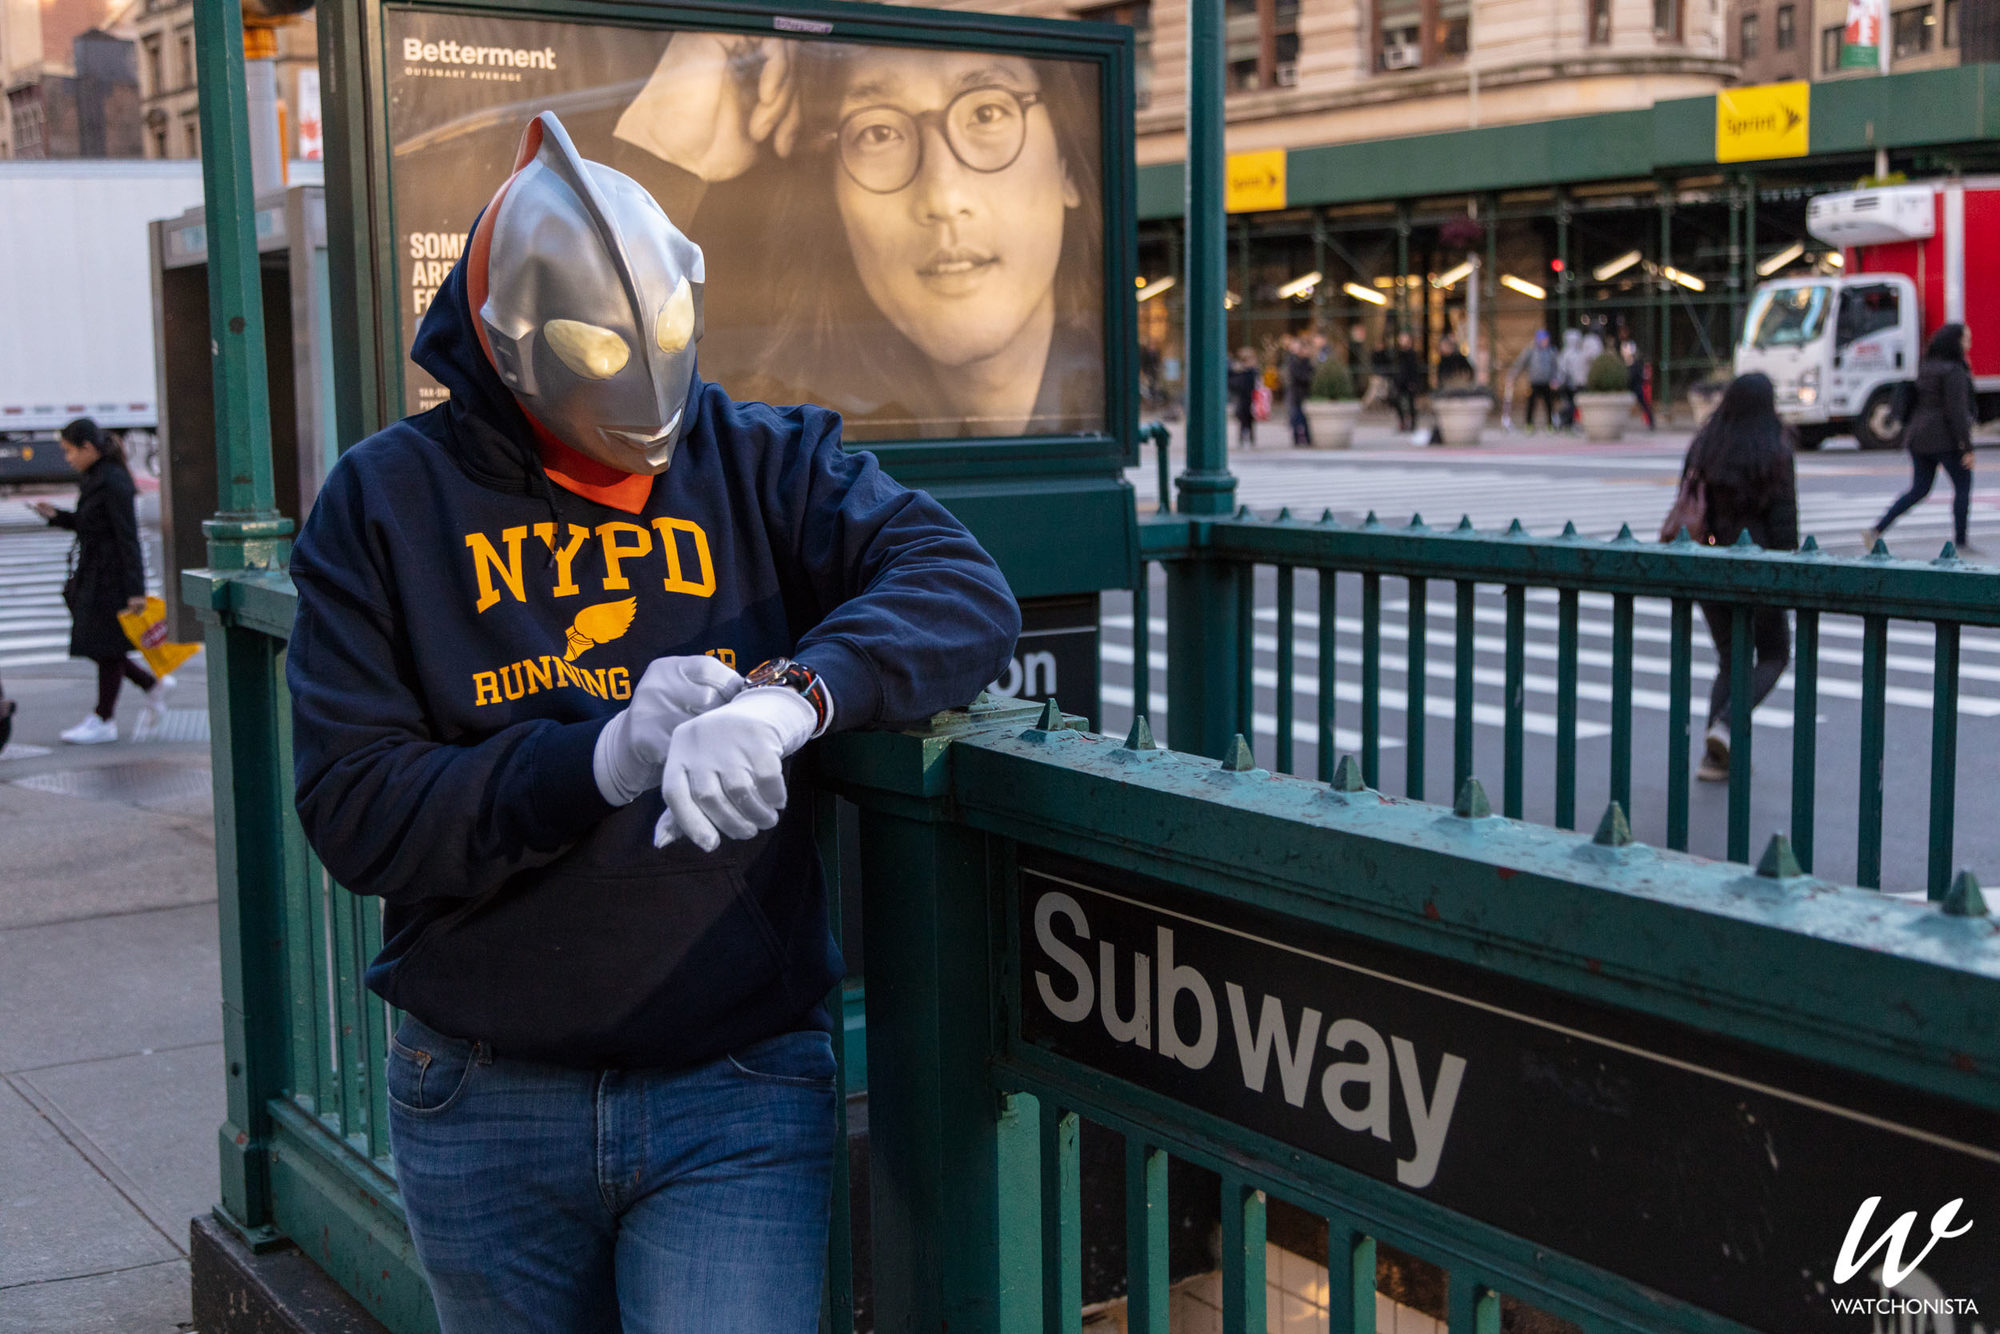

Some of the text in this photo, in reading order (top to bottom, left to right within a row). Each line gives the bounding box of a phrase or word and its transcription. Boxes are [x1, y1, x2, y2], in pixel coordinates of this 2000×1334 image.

[403, 38, 557, 70] Betterment
[404, 67, 522, 82] OUTSMART AVERAGE
[465, 517, 716, 614] NYPD
[472, 655, 632, 706] RUNNING
[1034, 891, 1467, 1189] Subway
